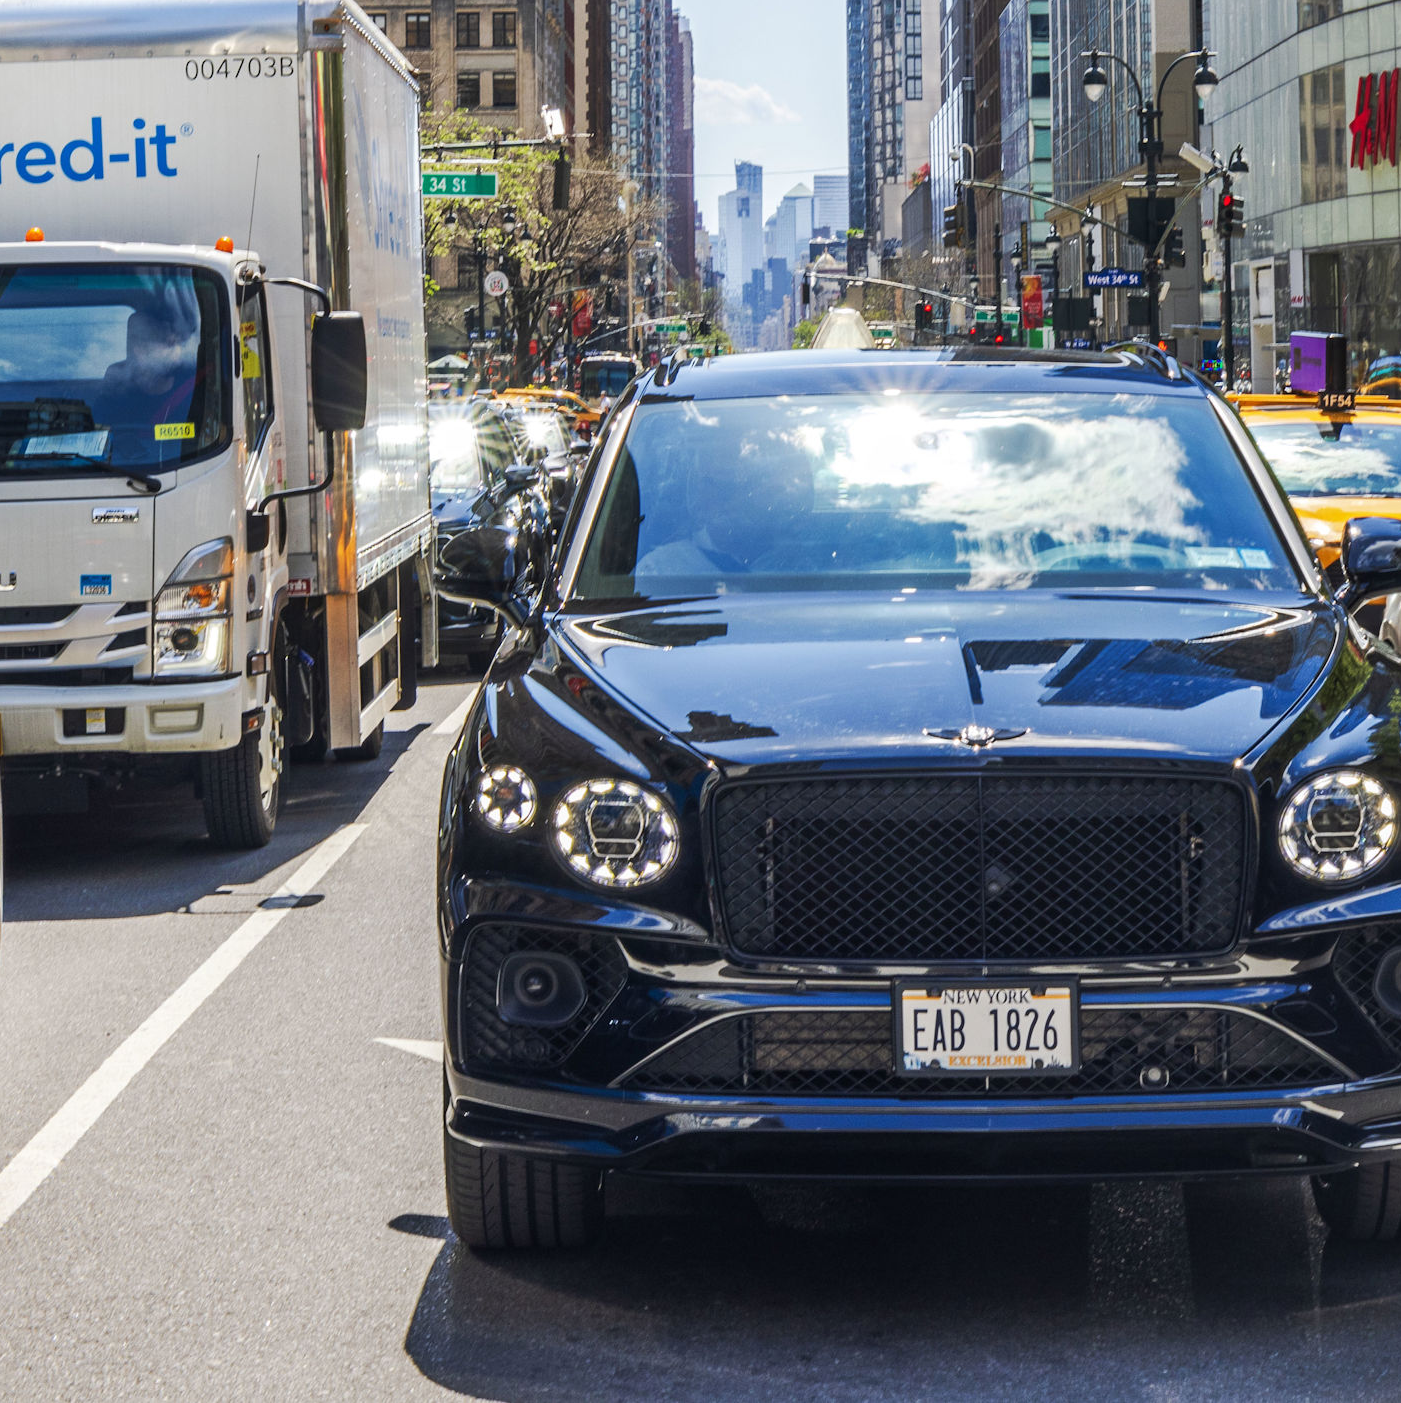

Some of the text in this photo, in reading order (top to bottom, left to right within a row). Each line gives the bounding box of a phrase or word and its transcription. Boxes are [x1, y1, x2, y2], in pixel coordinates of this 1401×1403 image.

[184, 56, 295, 81] 004703B
[429, 177, 467, 193] 34 St
[1087, 275, 1110, 285] West
[1129, 274, 1139, 285] St
[1323, 394, 1352, 407] 1F54
[943, 989, 1031, 1005] NEW YORK
[913, 1008, 1059, 1052] EAB 1826
[948, 1055, 1028, 1067] EXCELSIOR
